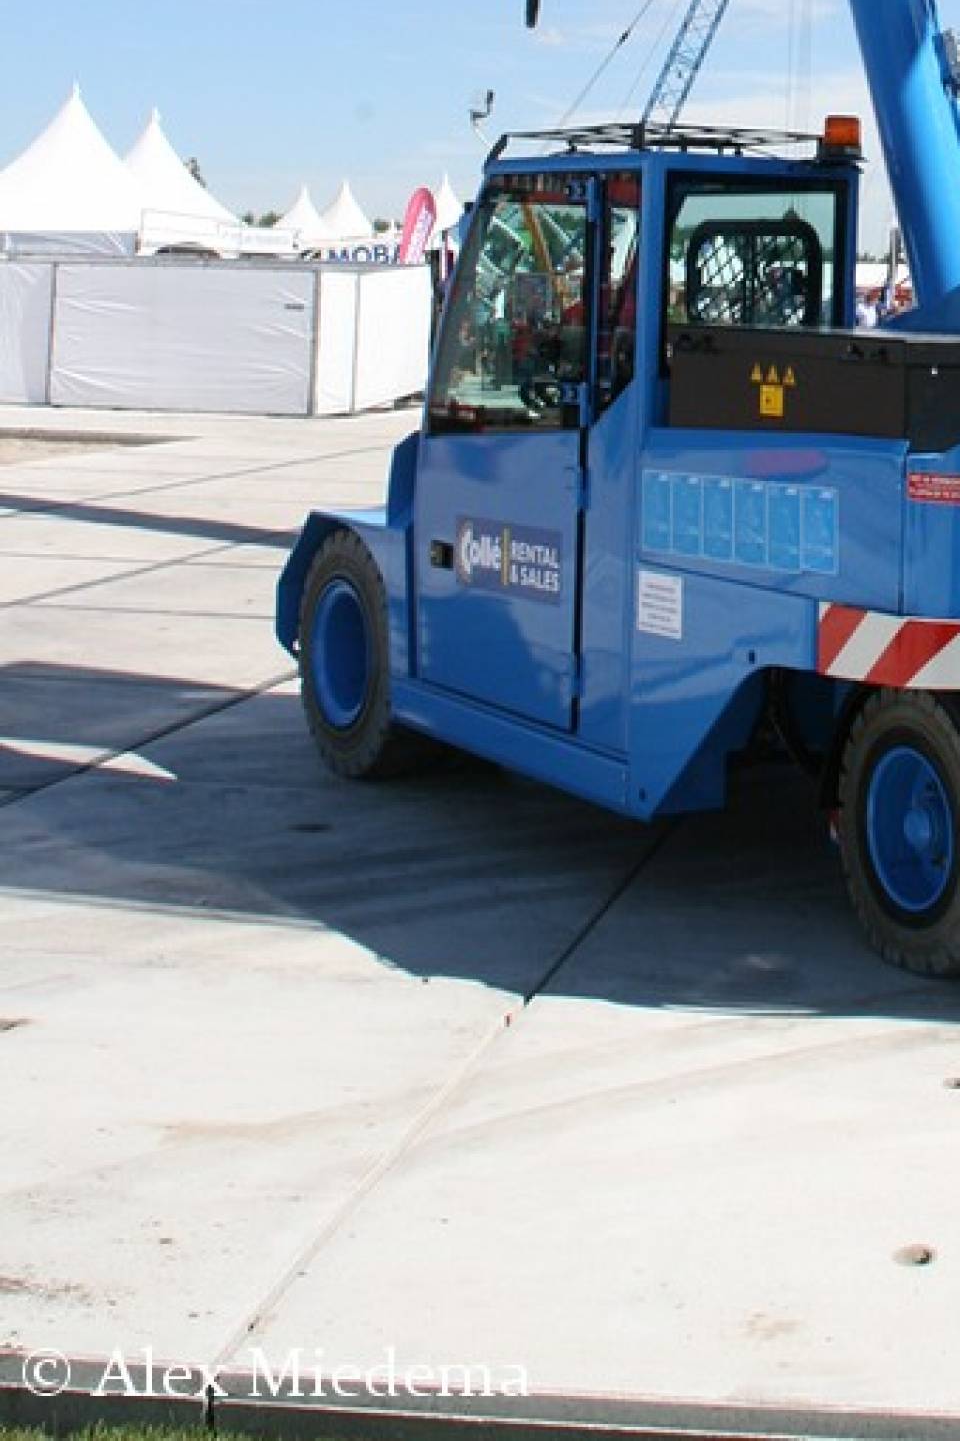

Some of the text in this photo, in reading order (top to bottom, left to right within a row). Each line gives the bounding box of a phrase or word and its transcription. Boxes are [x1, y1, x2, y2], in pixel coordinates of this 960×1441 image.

[460, 524, 502, 575] Collé
[511, 539, 560, 569] RENTAL
[520, 565, 561, 592] SALES
